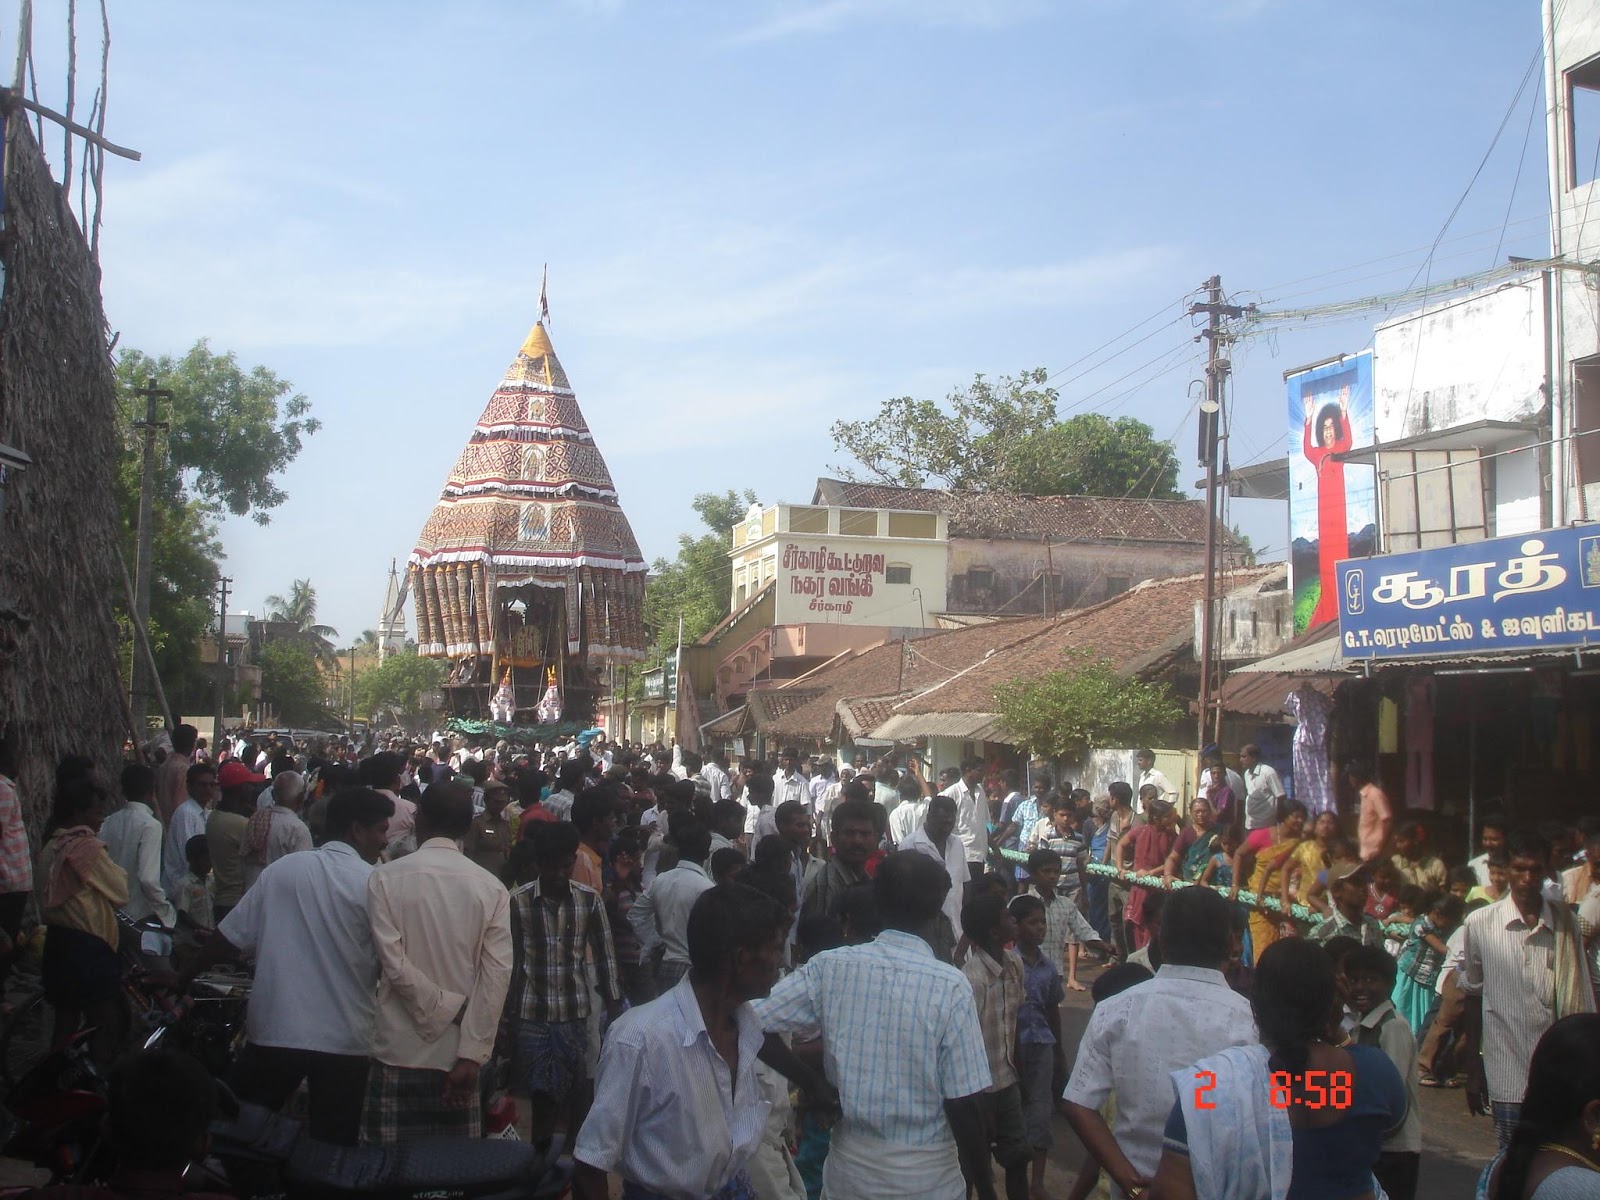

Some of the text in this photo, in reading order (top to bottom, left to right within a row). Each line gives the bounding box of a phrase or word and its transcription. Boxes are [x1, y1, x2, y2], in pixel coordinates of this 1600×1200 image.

[1372, 539, 1567, 610] சூரத்
[790, 575, 826, 598] நகர
[808, 598, 854, 614] சீர்காழி
[1481, 618, 1498, 639] &
